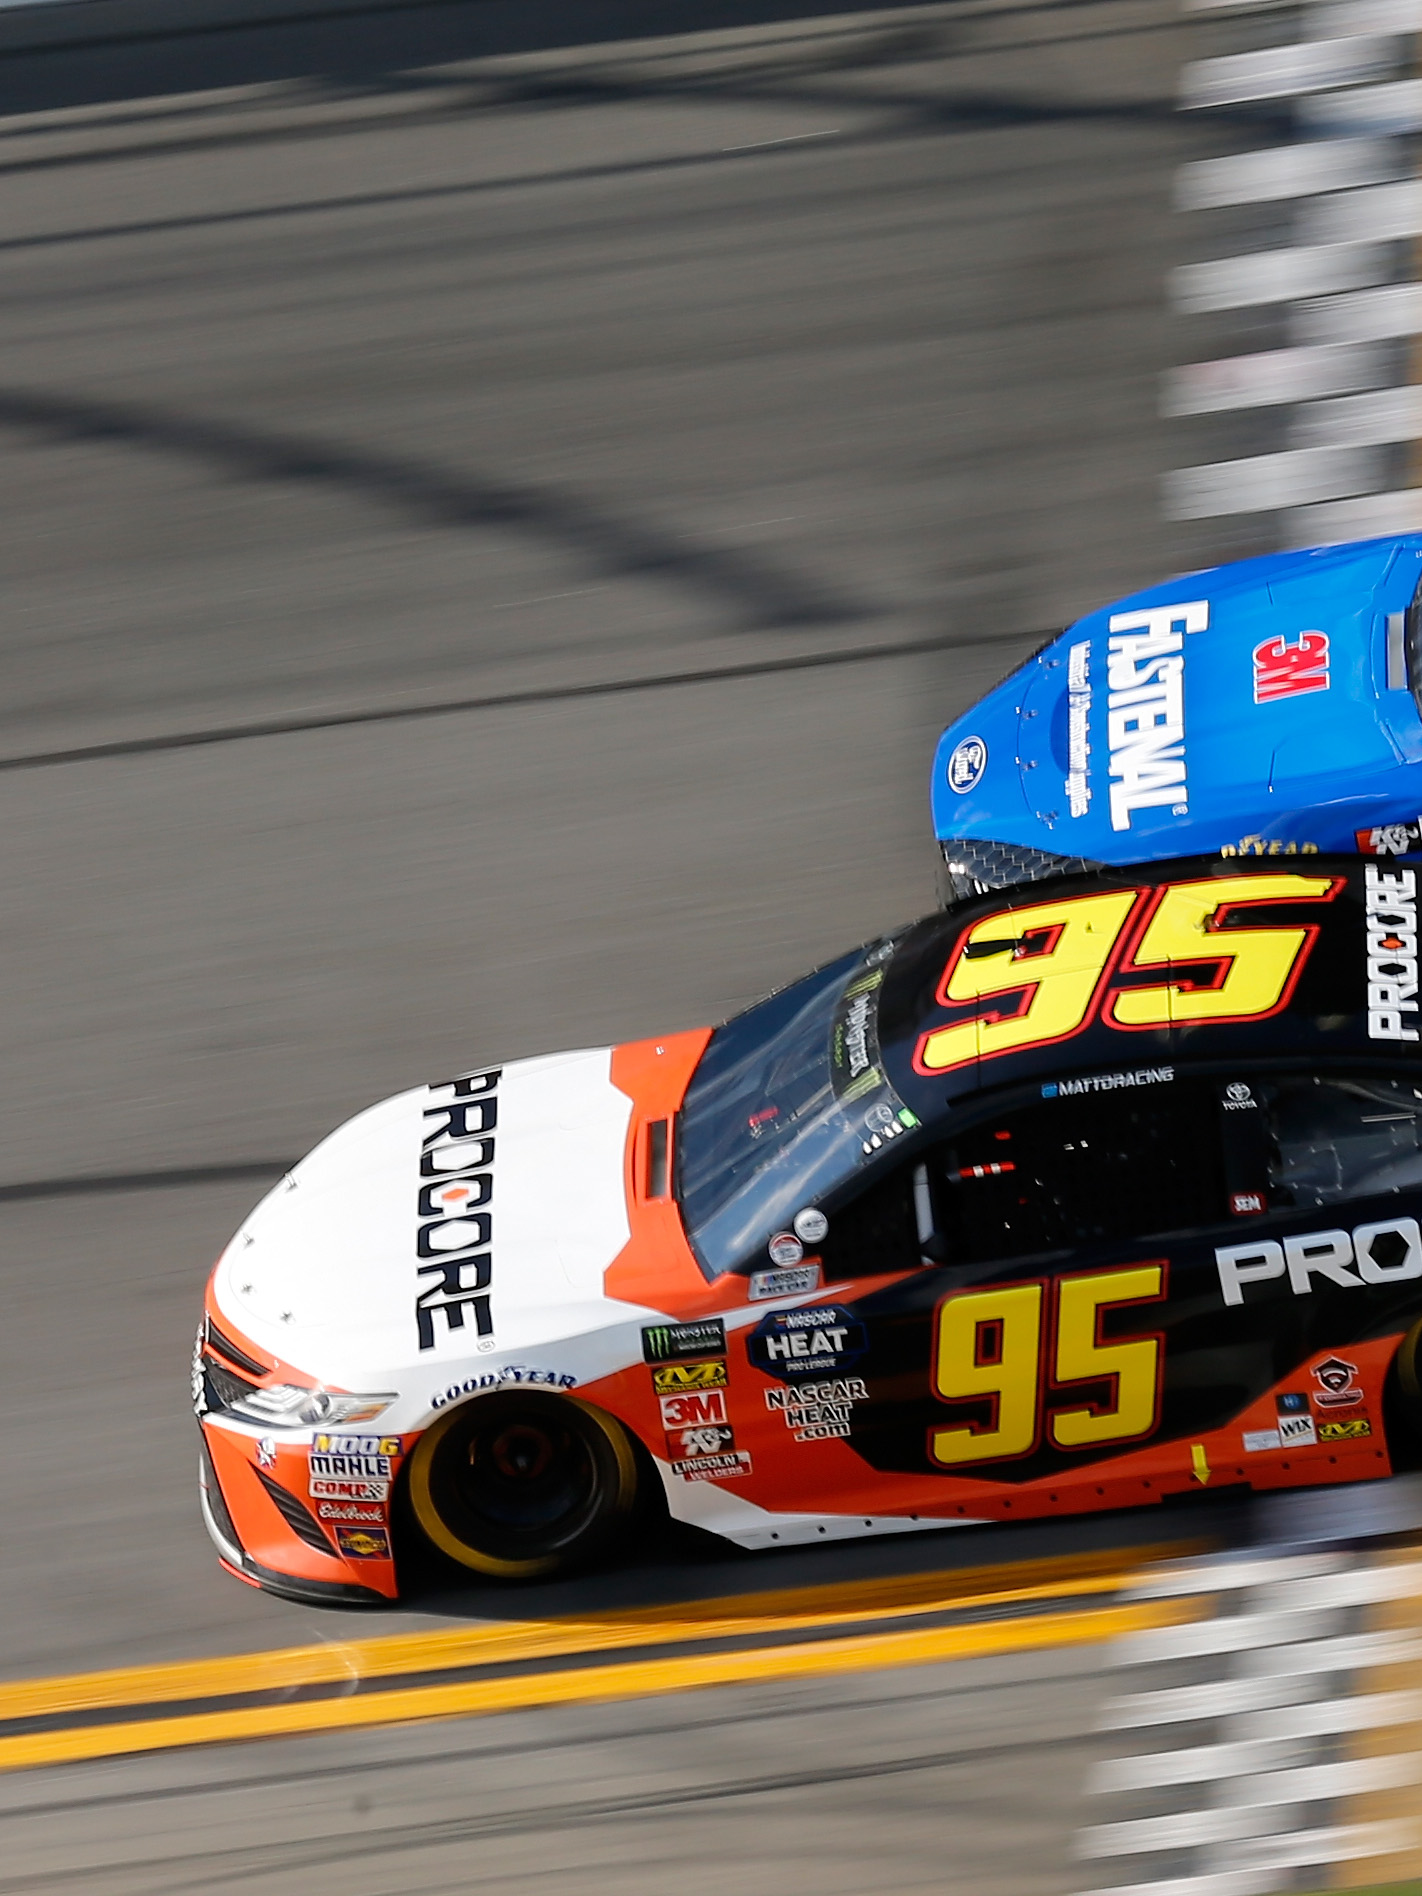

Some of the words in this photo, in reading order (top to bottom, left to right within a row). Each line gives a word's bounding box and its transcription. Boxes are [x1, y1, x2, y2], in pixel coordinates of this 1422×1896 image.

[1253, 630, 1331, 704] 3M
[1108, 600, 1209, 831] FASTENAL
[1365, 863, 1419, 1041] PROCORE
[913, 873, 1345, 1075] 95
[1223, 1100, 1258, 1111] TOYOTA
[418, 1069, 502, 1352] PROCORE
[786, 1309, 837, 1328] NASCAR
[766, 1326, 848, 1360] HEAT
[931, 1263, 1166, 1467] 95
[765, 1377, 869, 1410] NASCAR
[665, 1393, 724, 1425] 3M
[787, 1402, 853, 1428] HEAT
[795, 1422, 851, 1441] .com
[1281, 1417, 1311, 1438] WIX
[314, 1435, 400, 1456] MOOG
[311, 1456, 389, 1476] MAHLE
[674, 1455, 737, 1475] LINCOLN
[689, 1466, 745, 1480] WELDERS
[314, 1481, 369, 1497] COMP
[319, 1502, 384, 1522] Edelbrock
